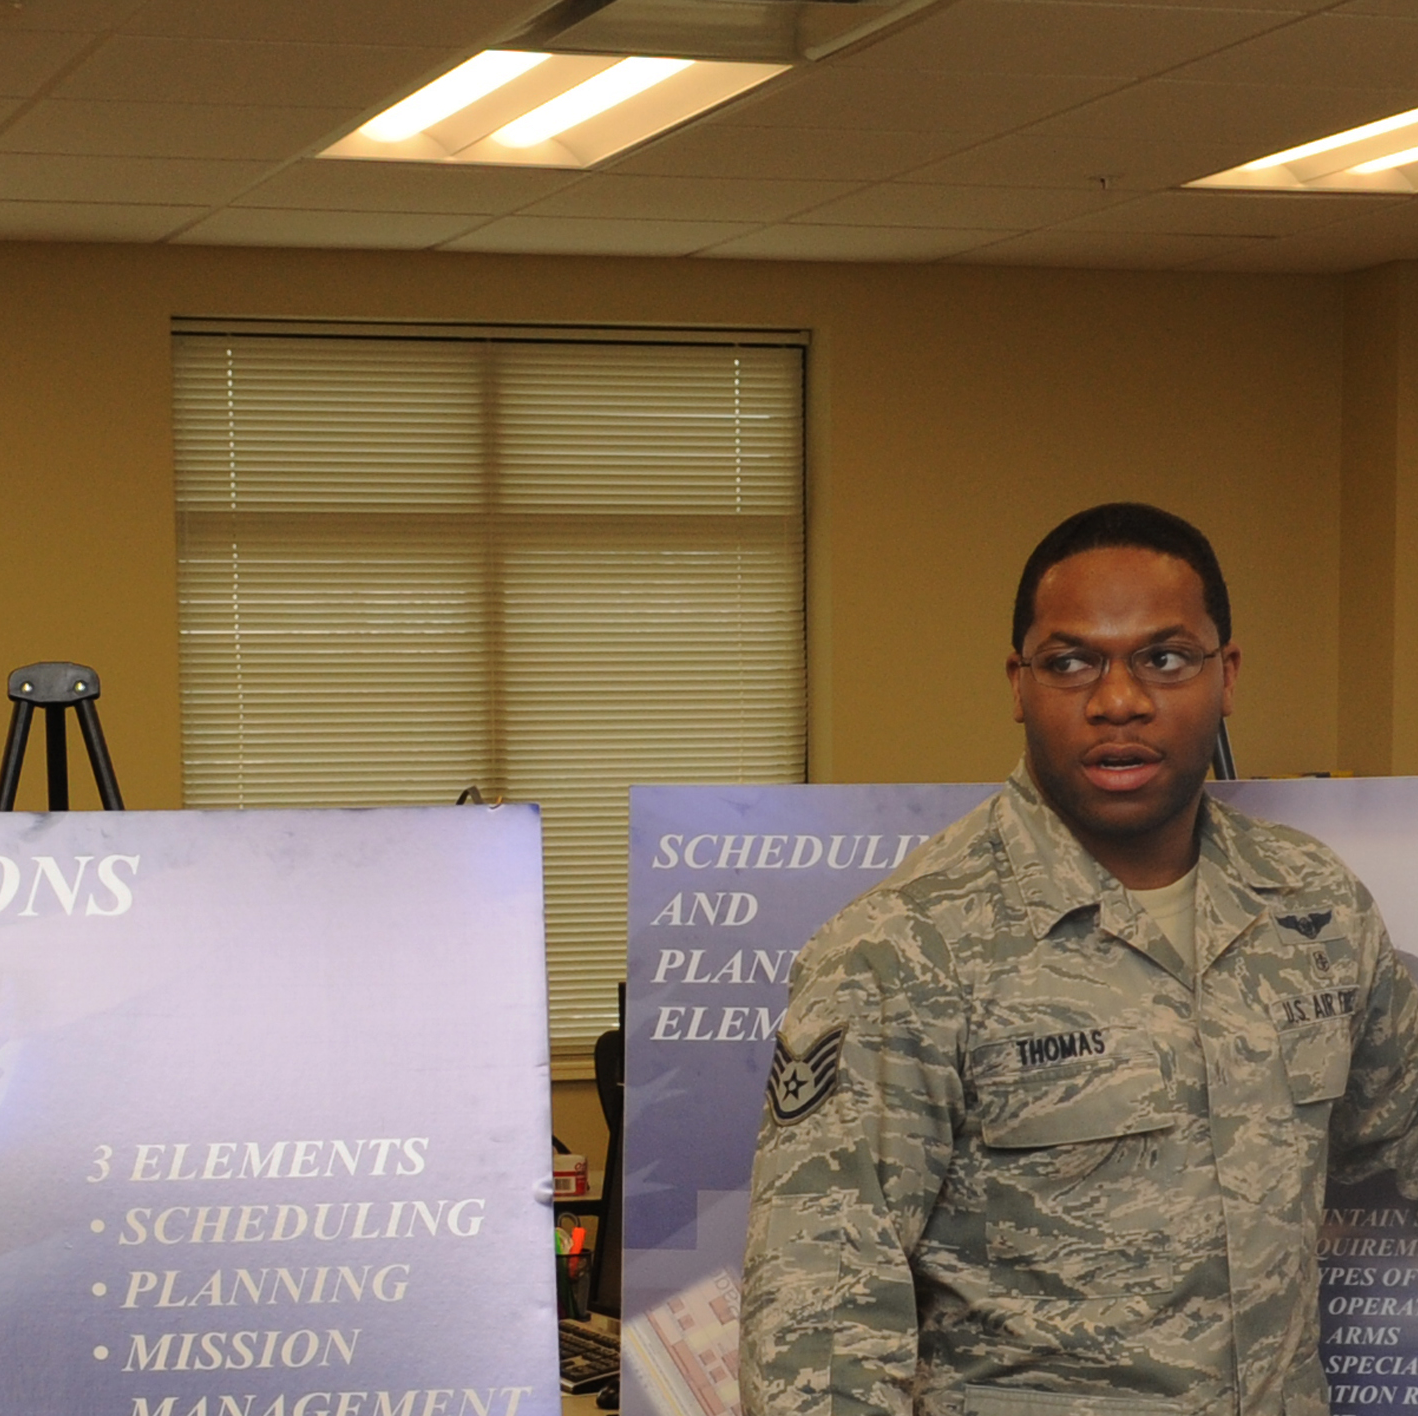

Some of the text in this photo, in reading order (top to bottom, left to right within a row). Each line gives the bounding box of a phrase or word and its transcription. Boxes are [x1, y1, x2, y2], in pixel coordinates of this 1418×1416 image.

[651, 833, 930, 870] SCHEDULI
[650, 891, 759, 927] AND
[1312, 993, 1337, 1020] AIR
[1016, 1030, 1105, 1066] THOMAS
[86, 1137, 429, 1183] 3 ELEMENTS
[119, 1199, 485, 1246] SCHEDULING
[119, 1264, 410, 1309] PLANNING
[1382, 1267, 1418, 1287] OF
[121, 1329, 362, 1371] MISSION
[1325, 1326, 1401, 1346] ARMS
